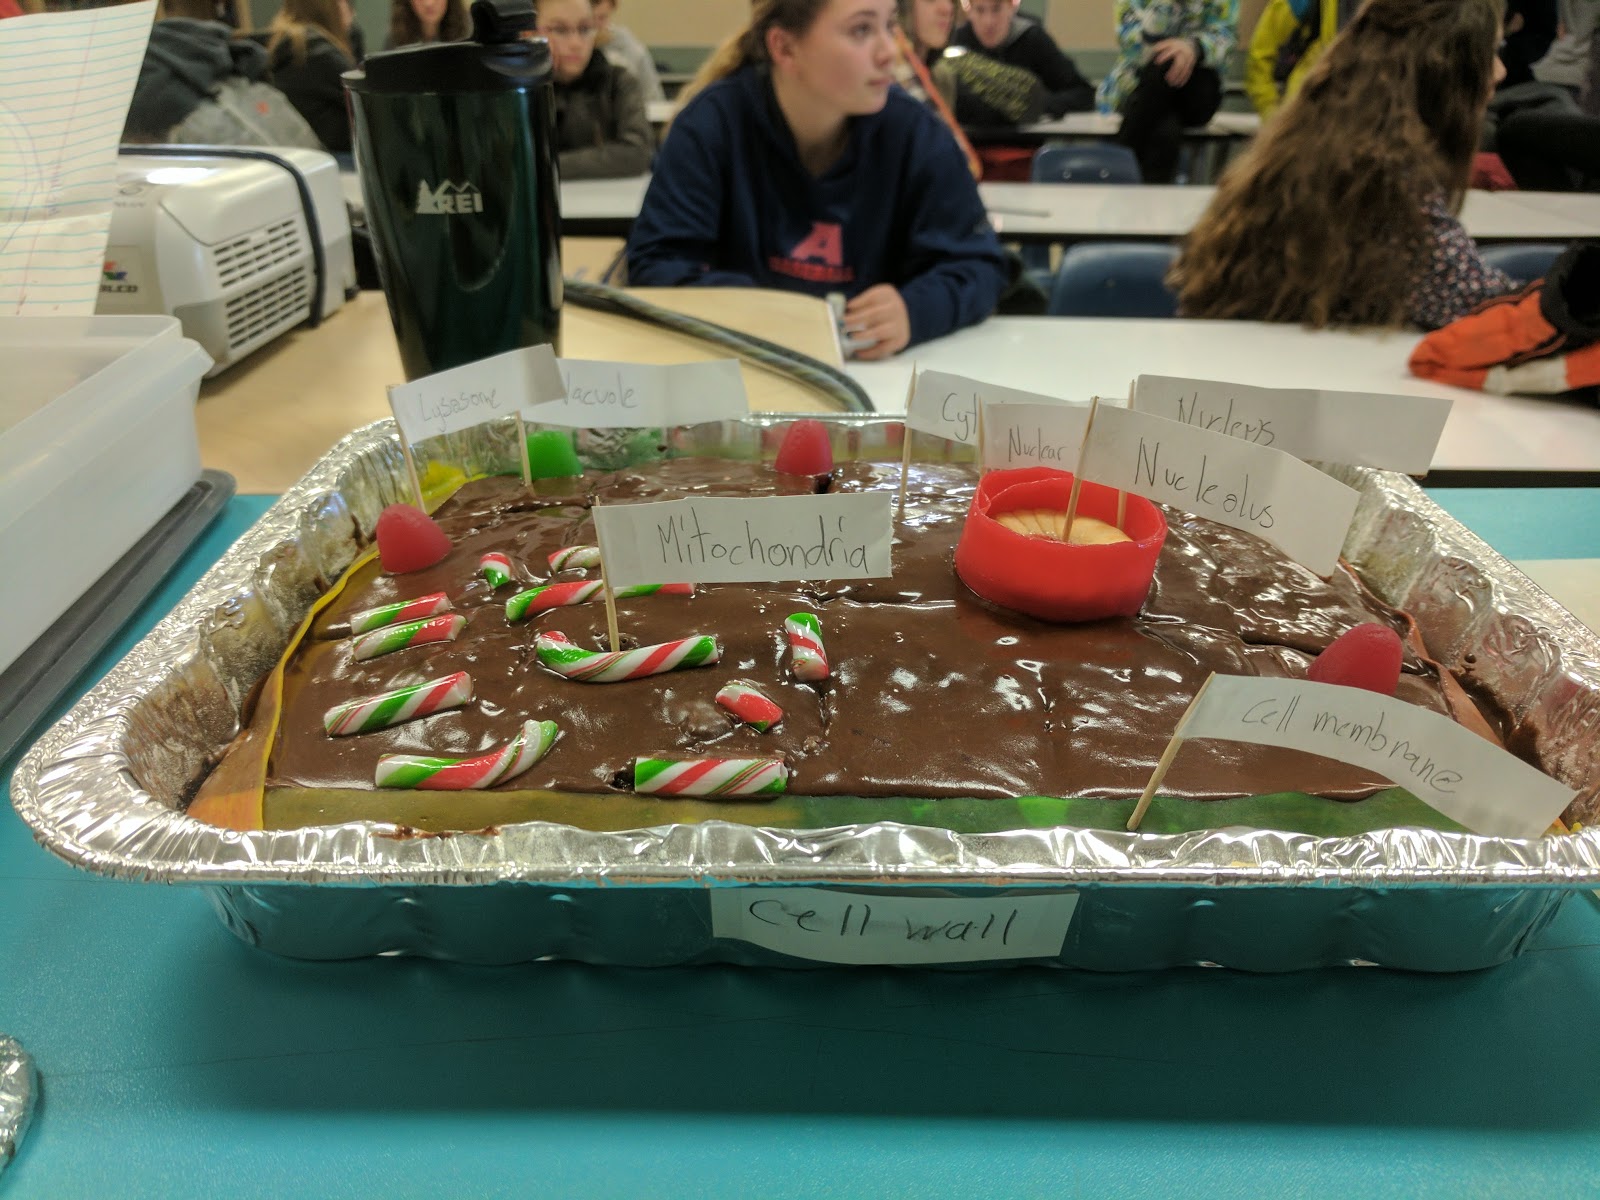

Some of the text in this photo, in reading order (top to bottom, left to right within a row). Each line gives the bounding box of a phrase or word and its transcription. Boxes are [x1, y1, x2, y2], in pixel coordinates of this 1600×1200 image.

[438, 192, 484, 214] REI
[790, 222, 843, 267] A
[1008, 424, 1067, 463] Nuclear
[1134, 436, 1275, 529] Nucleolus
[657, 506, 869, 574] Mitochondria
[1312, 711, 1464, 794] membrane
[748, 899, 1018, 946] Cell wall
